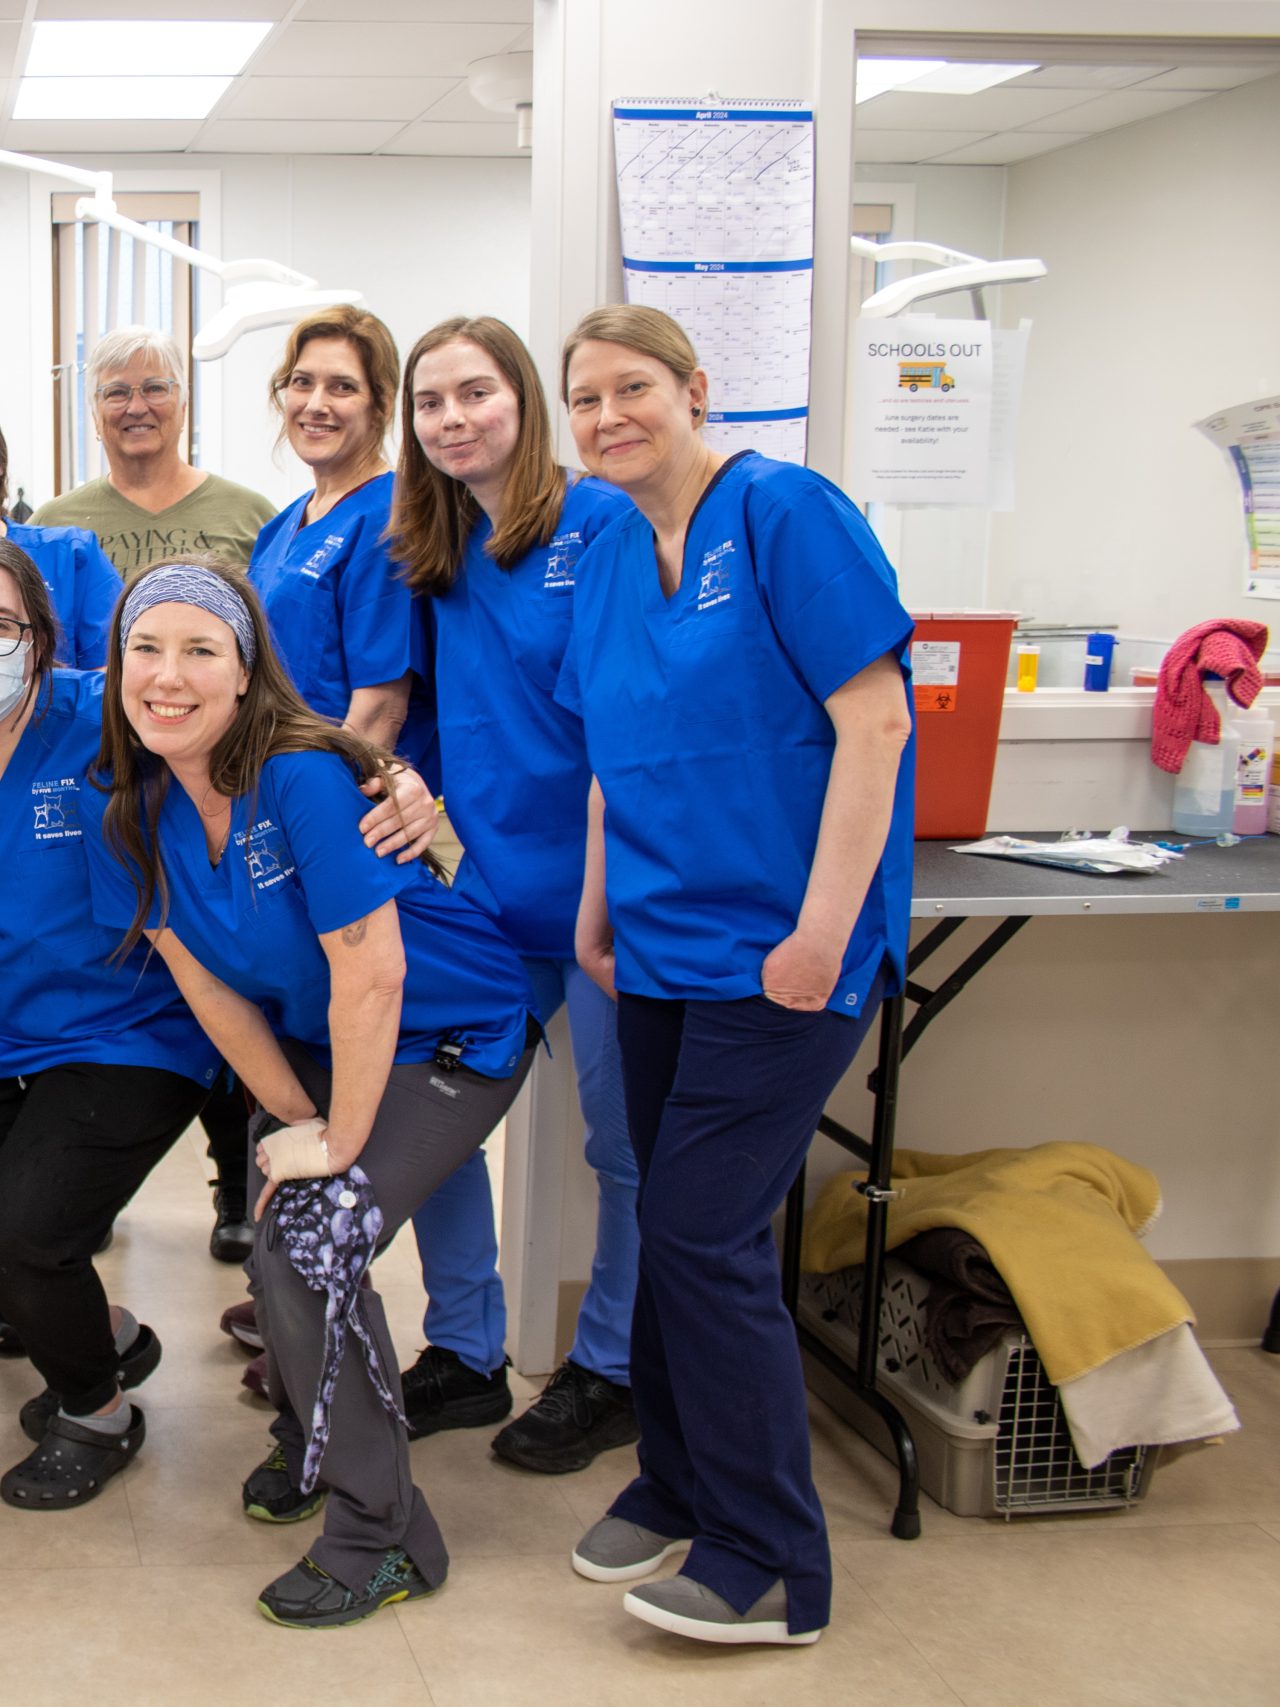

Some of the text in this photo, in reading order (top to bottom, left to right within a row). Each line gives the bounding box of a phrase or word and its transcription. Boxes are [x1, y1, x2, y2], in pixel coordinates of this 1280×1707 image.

[696, 112, 711, 120] April
[694, 263, 724, 272] May 2024
[950, 344, 982, 357] OUT
[100, 528, 214, 550] PAYING &
[32, 780, 59, 788] FELINE
[258, 819, 272, 830] FIX
